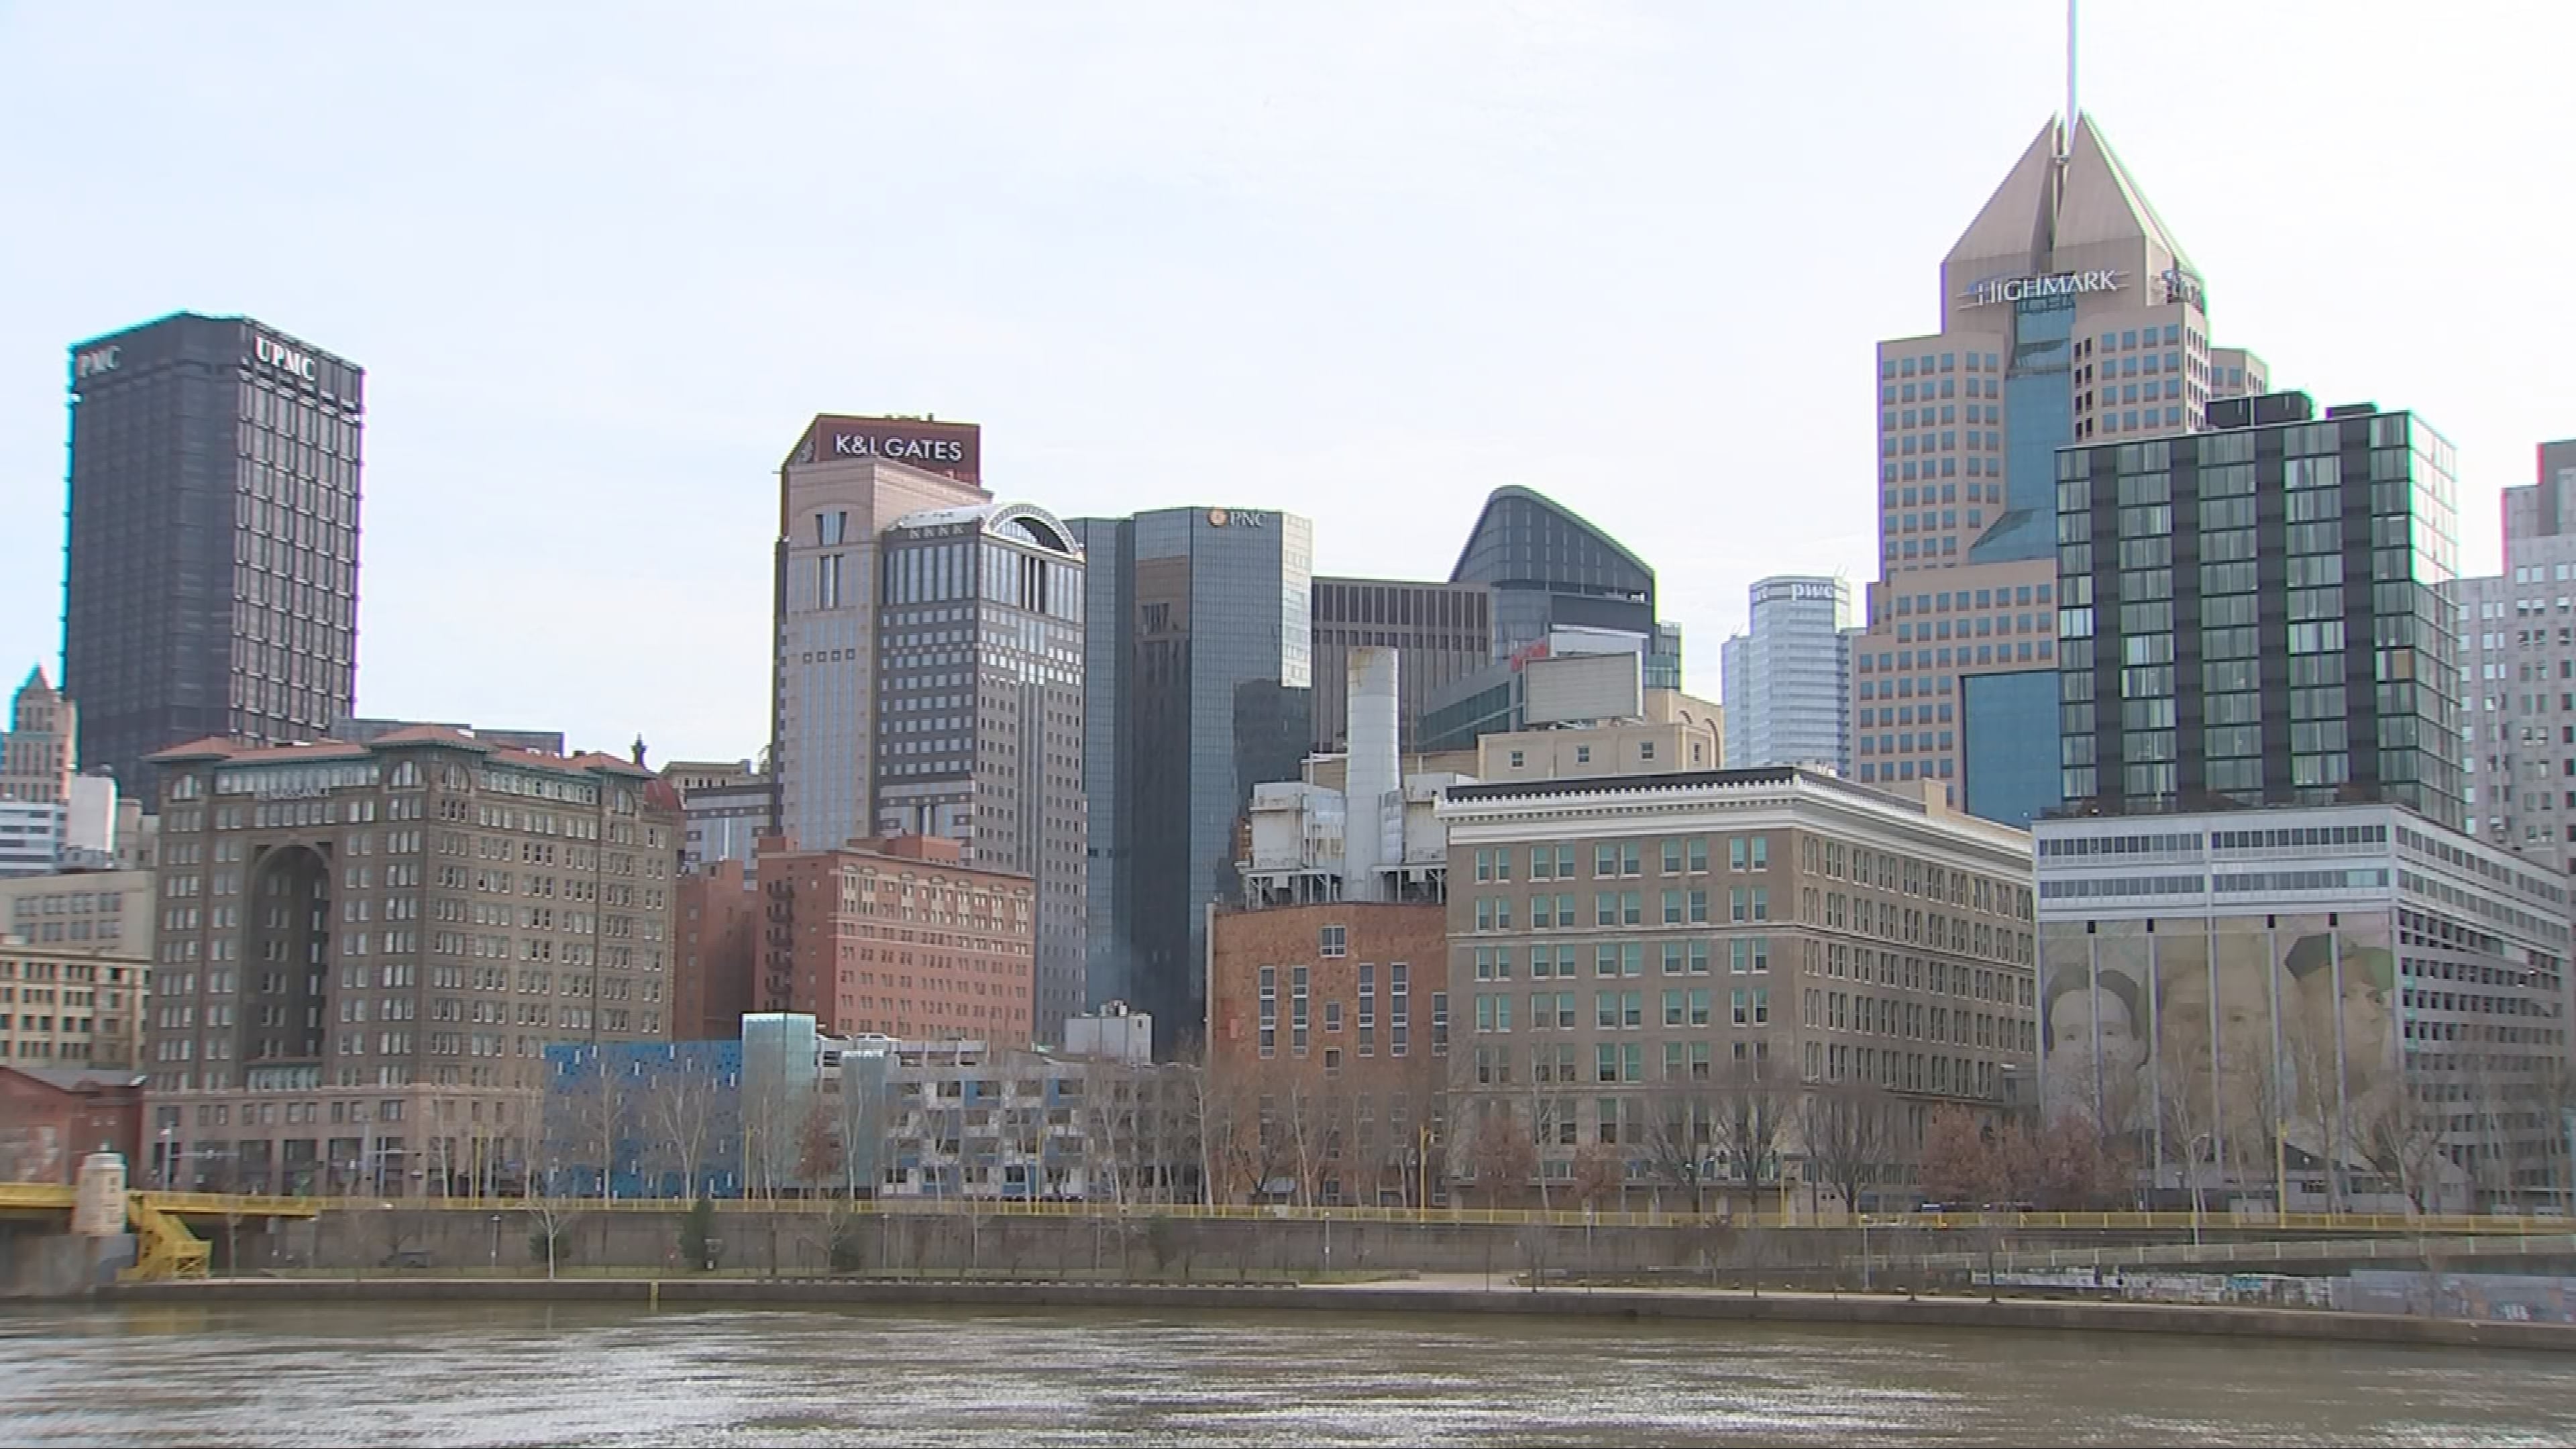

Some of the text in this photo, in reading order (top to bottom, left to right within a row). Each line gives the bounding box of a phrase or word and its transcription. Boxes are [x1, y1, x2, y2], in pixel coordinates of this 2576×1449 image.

[1978, 270, 2117, 306] HIGHMARK
[77, 345, 121, 378] PMC
[256, 335, 316, 381] UPMC
[836, 434, 880, 455] K&L
[884, 437, 962, 462] GATES
[1230, 511, 1267, 527] PNC
[1791, 584, 1833, 601] pwc
